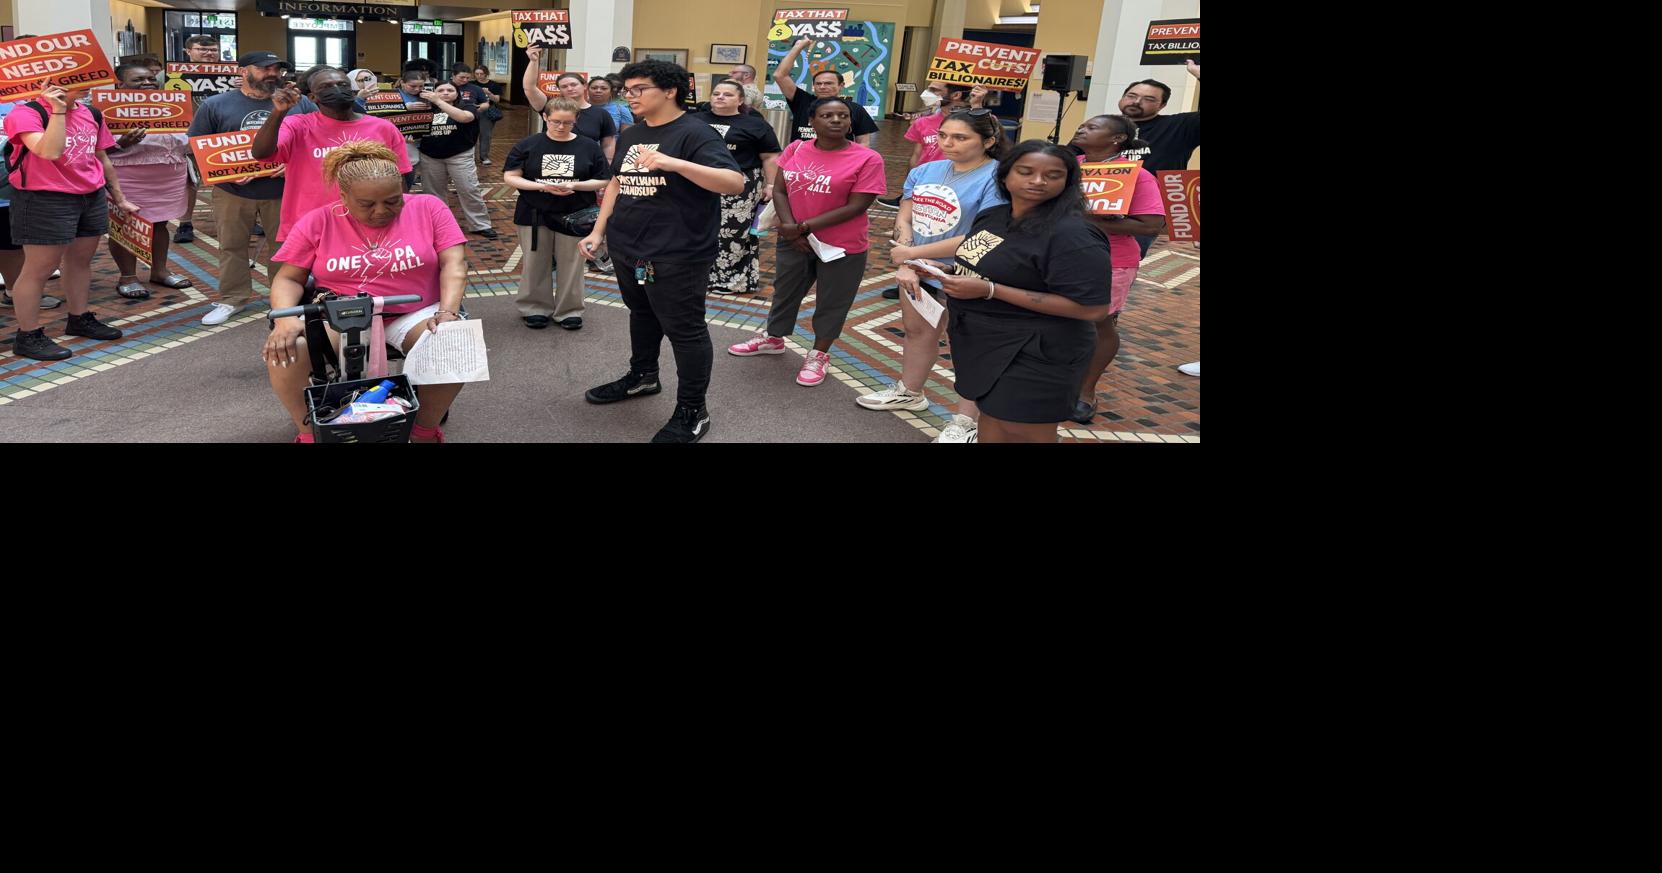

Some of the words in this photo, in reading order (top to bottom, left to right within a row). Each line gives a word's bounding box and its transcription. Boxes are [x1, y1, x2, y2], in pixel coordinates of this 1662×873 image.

[280, 2, 397, 15] INFORMATION
[513, 12, 533, 21] TAX
[534, 11, 566, 21] THAT
[807, 10, 844, 18] THAT
[1150, 26, 1200, 36] PREVEN
[0, 43, 33, 60] ND
[36, 34, 92, 53] OUR
[945, 41, 1037, 62] PREVENT
[2, 56, 79, 80] NEEDS
[171, 64, 200, 73] TAX
[201, 64, 239, 74] THAT
[934, 58, 974, 74] TAX
[977, 58, 1032, 75] CUTS!
[59, 70, 110, 87] GREED
[97, 92, 146, 103] FUND
[150, 92, 187, 103] OUR
[116, 107, 172, 118] NEEDS
[153, 120, 190, 129] GREED
[196, 133, 251, 150] FUND
[207, 168, 231, 178] NOT
[783, 170, 796, 181] NE
[815, 175, 832, 186] PA
[1164, 174, 1186, 202] OUR
[1170, 203, 1193, 238] FUND
[326, 255, 362, 272] ONE
[393, 245, 416, 262] PA
[390, 256, 424, 272] 4ALL
